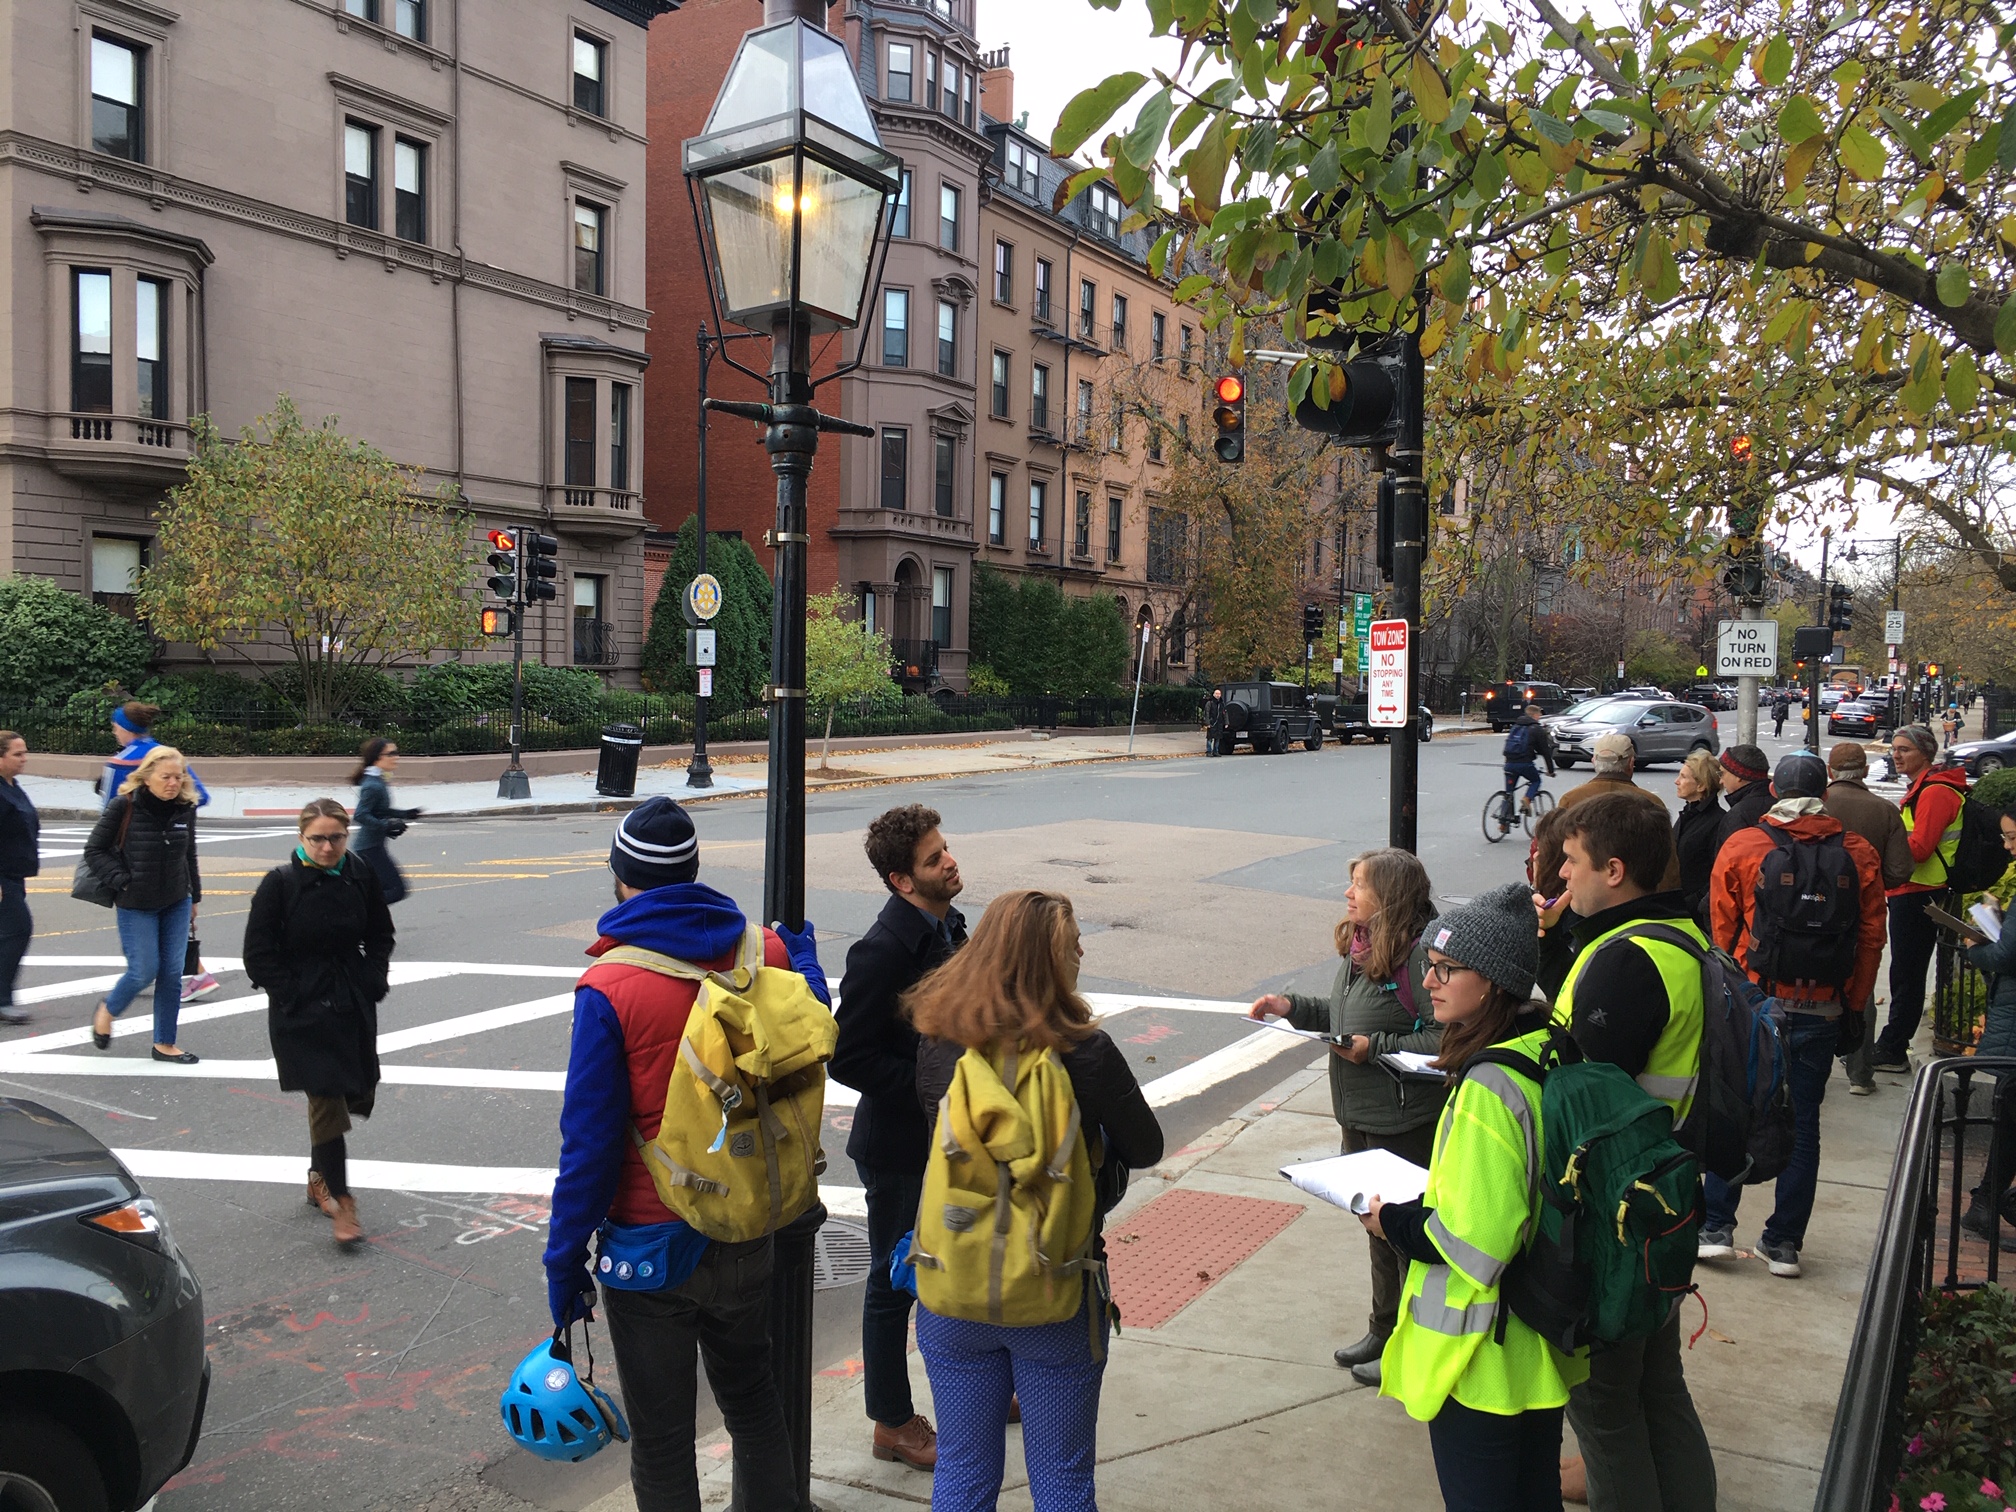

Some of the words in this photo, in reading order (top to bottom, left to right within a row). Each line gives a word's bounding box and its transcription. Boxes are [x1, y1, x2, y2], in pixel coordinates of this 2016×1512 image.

[1888, 620, 1902, 629] 25
[1373, 631, 1387, 646] TOW
[1388, 630, 1404, 646] ZONE
[1737, 628, 1758, 640] NO
[1729, 642, 1766, 654] TURN
[1381, 653, 1395, 667] NO
[1721, 656, 1741, 668] ON
[1744, 656, 1772, 668] RED
[1373, 668, 1403, 678] STOPPING
[1382, 680, 1393, 688] ANY
[1381, 689, 1394, 698] TIME
